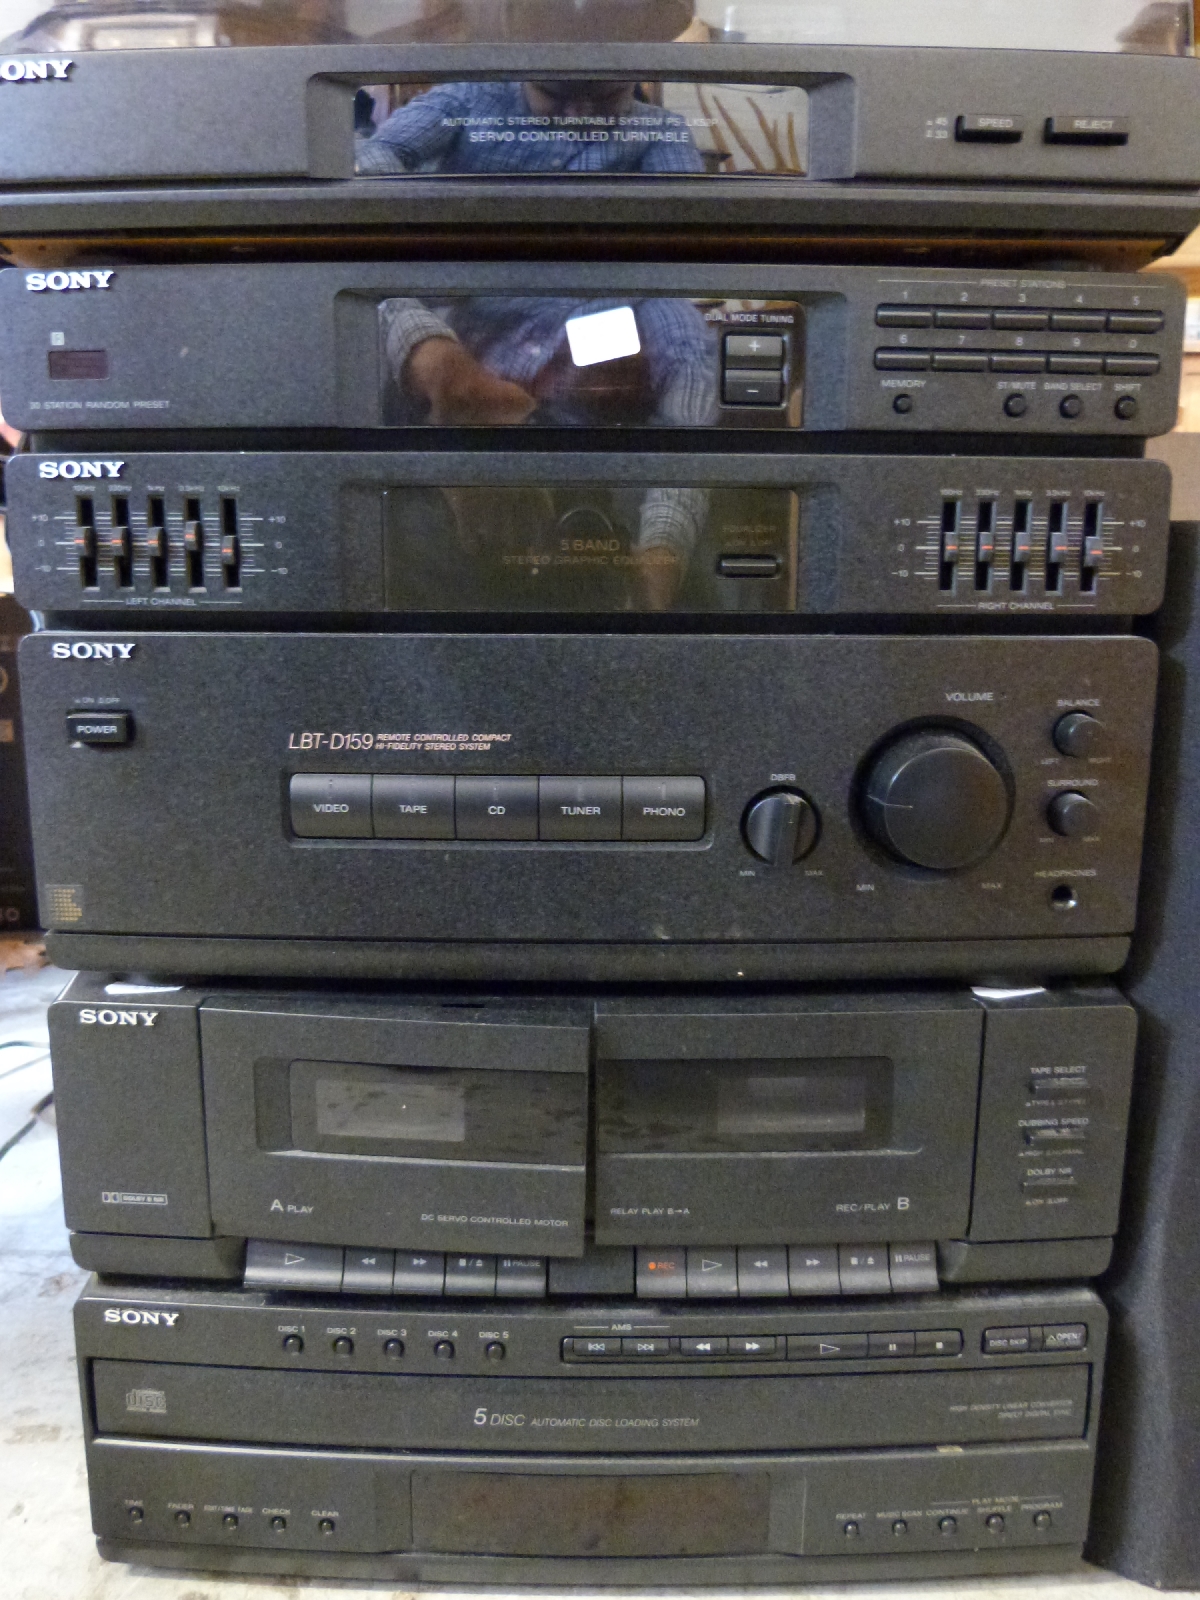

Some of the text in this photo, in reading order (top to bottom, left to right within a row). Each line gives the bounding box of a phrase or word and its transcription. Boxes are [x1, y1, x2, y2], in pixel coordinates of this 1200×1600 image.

[0, 60, 73, 81] ONY
[442, 118, 504, 126] AUTOMATIC
[508, 117, 550, 126] STEREO
[553, 116, 616, 126] TURNTABLE
[618, 118, 662, 126] SYSTEM
[978, 118, 1013, 128] SPEED
[1074, 120, 1114, 130] REJECT
[470, 132, 689, 142] SERVO CONTROLLED TURNTABLE
[25, 270, 114, 291] SONY
[980, 278, 1066, 289] PRESET STATIONS
[903, 291, 908, 300] 1
[960, 292, 968, 302] 2
[1019, 294, 1026, 302] 3
[1075, 295, 1083, 304] 4
[1132, 296, 1140, 306] 5
[705, 313, 794, 324] DUAL MODE TUNING
[900, 335, 908, 344] 6
[958, 335, 966, 344] 7
[1015, 336, 1024, 346] 8
[1072, 338, 1081, 347] 9
[880, 380, 926, 388] MEMORY
[1044, 382, 1102, 390] BAND SELECT
[1114, 383, 1142, 392] SHIFT
[44, 401, 82, 410] STATION
[86, 400, 130, 409] RANDOM
[134, 400, 170, 408] PRESET
[39, 461, 124, 479] SONY
[268, 516, 286, 524] +10
[894, 518, 911, 526] +10
[560, 539, 620, 551] 5 BAND
[503, 555, 549, 564] STEREO
[554, 555, 608, 565] GRAPHIC
[151, 598, 196, 606] CHANNEL
[978, 602, 1055, 610] RIGHT CHANNEL
[52, 643, 136, 659] SONY
[945, 692, 994, 702] VOLUME
[76, 726, 118, 734] POWER
[288, 732, 374, 750] LBT-D159
[414, 734, 469, 742] CONTROLLED
[472, 734, 512, 742] COMPACT
[374, 742, 422, 750] HI-FIDELITY
[770, 773, 796, 782] DBFB
[313, 804, 349, 813] VIDEO
[400, 805, 428, 814] TAPE
[488, 806, 506, 816] CD
[561, 806, 601, 816] TUNER
[643, 807, 686, 817] PHONO
[1034, 870, 1096, 878] HEADPHONES
[856, 884, 875, 892] MIN
[80, 1008, 158, 1026] SONY
[1054, 1066, 1086, 1074] SELECT
[1018, 1119, 1058, 1127] DUBBING
[1027, 1168, 1056, 1176] DOLBY
[270, 1199, 314, 1214] A PLAY
[836, 1196, 910, 1212] REC/PLAY B
[610, 1207, 664, 1216] RELAY PLAY
[421, 1214, 568, 1227] DC SERVO CONTROLLED MOTOR
[904, 1254, 930, 1262] PAUSE
[657, 1262, 675, 1270] REC
[104, 1308, 180, 1327] SONY
[989, 1338, 1028, 1347] DISC SKIP
[474, 1408, 700, 1427] 5 DISC AUTOMATIC DISC LOADING SYSTEM
[168, 1502, 194, 1510] FADER
[977, 1505, 1012, 1514] SHUFFLE
[1020, 1502, 1062, 1510] PROGRAM
[876, 1510, 922, 1519] MUSIC SCAN
[926, 1508, 968, 1516] CONTINUE
